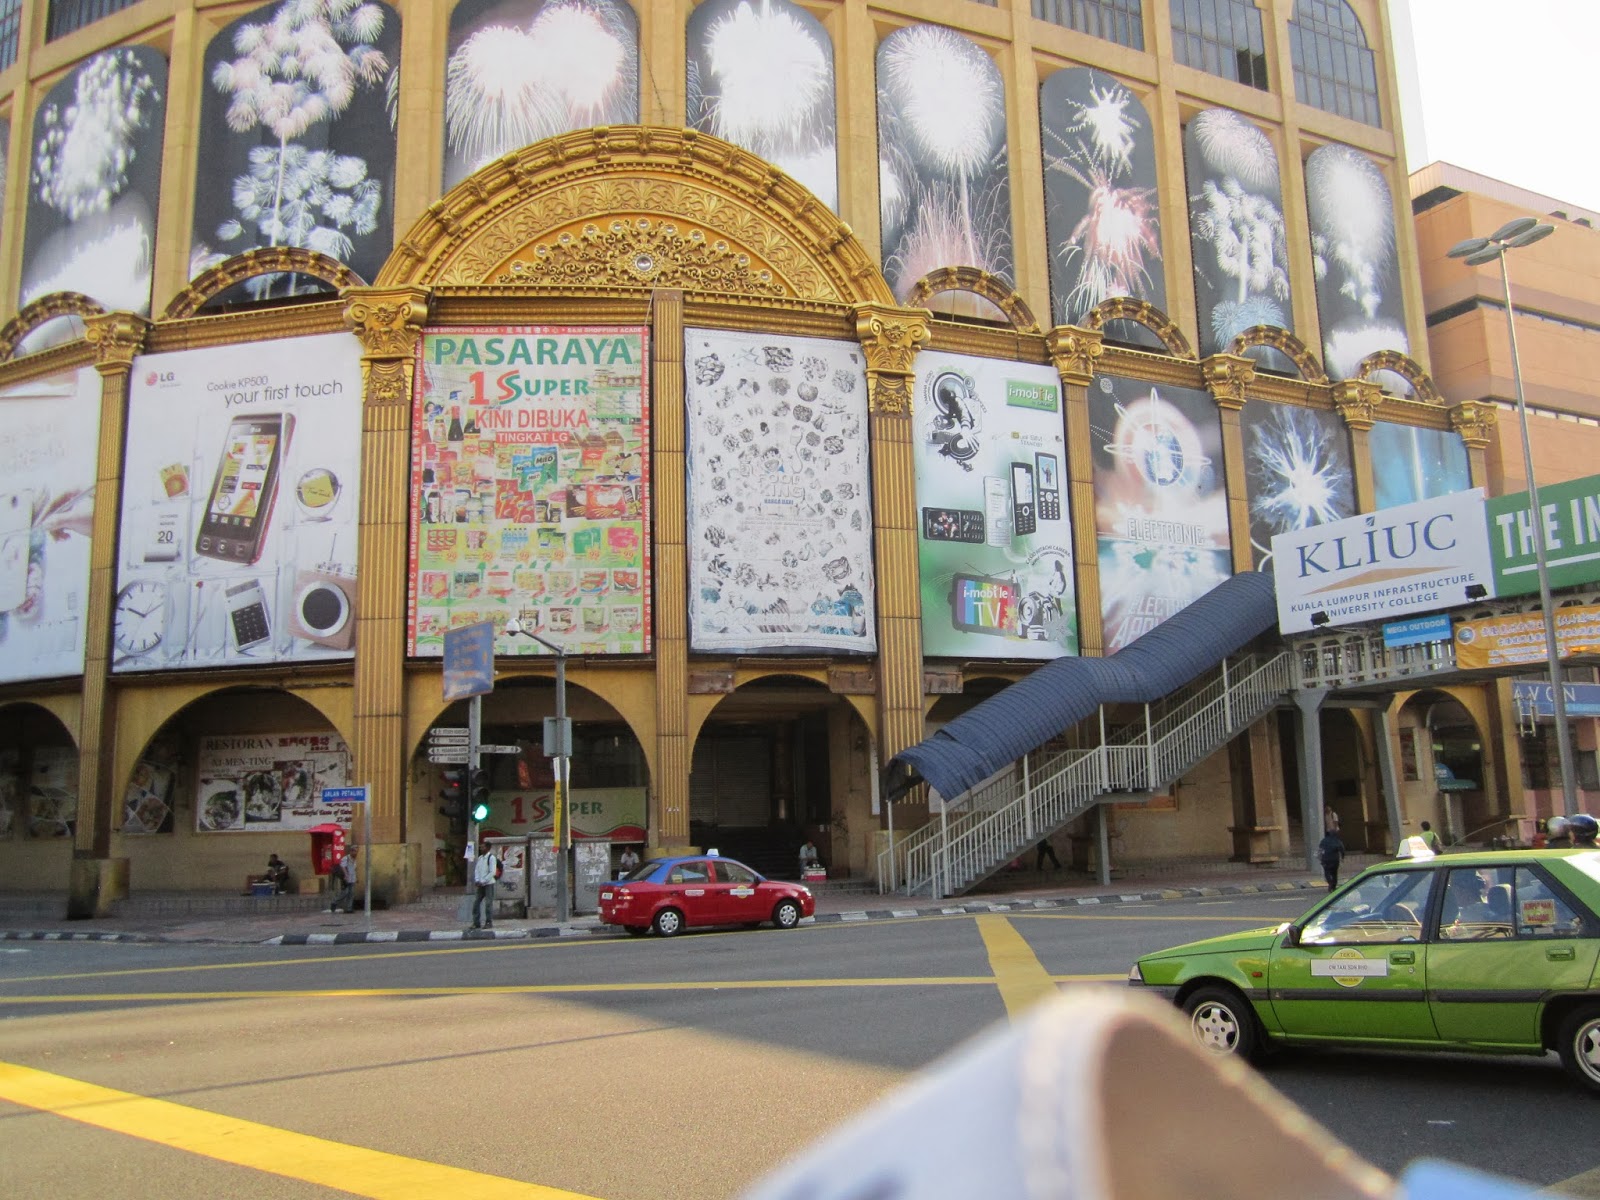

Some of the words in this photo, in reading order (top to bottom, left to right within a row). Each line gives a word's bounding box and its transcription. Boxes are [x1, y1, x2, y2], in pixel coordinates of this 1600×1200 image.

[435, 338, 632, 365] PASARAYA
[160, 372, 175, 382] LG
[207, 382, 236, 391] Cookie
[238, 376, 268, 389] KP500
[225, 390, 260, 408] your
[264, 385, 289, 401] first
[295, 380, 343, 398] touch
[1009, 384, 1054, 401] i-mobile
[474, 409, 512, 429] KINI
[518, 409, 590, 428] DIBUKA
[497, 432, 549, 443] TINGKAT
[552, 432, 568, 442] LG
[1127, 517, 1205, 546] ELECTRONIC
[1496, 504, 1562, 558] THE
[963, 585, 1008, 599] i-mobile
[1291, 600, 1324, 612] KUALA
[1326, 592, 1370, 606] LUMPUR
[1373, 573, 1475, 598] INFRASTRUCTURE
[1389, 592, 1440, 607] COLLEGE
[974, 602, 1001, 627] TV
[1386, 625, 1407, 633] MEGA
[1409, 619, 1446, 632] OUTDOOR
[206, 738, 273, 750] RESTORAN
[324, 790, 339, 798] JALAN
[341, 789, 364, 797] PETALING
[532, 795, 603, 823] SPER
